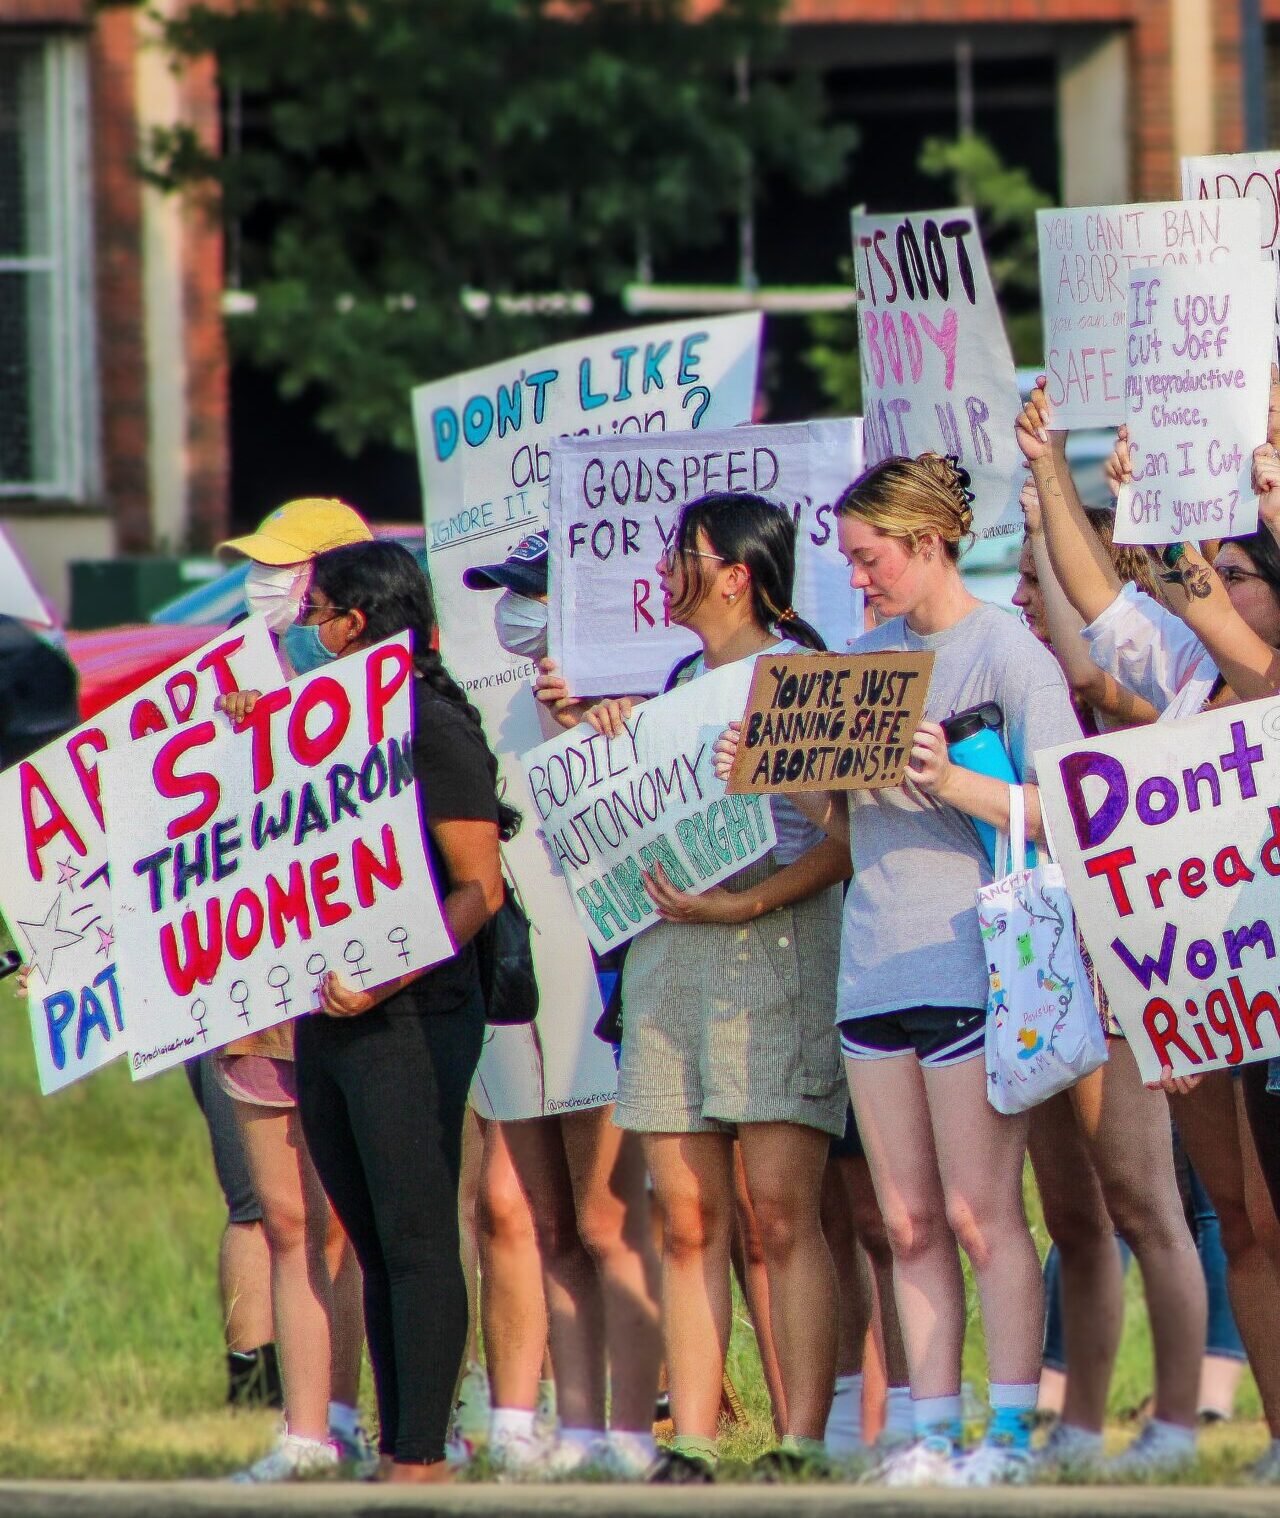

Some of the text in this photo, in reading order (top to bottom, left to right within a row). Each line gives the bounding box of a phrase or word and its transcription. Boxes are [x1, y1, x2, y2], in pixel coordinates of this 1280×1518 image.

[1045, 206, 1221, 251] YOU CAN'T BAN
[896, 216, 976, 305] NOT
[1128, 326, 1229, 367] cut off
[1130, 278, 1230, 357] If you
[863, 307, 959, 391] BODY
[1049, 348, 1120, 407] SAFE
[432, 332, 710, 461] DON'T LIKE
[1125, 374, 1143, 413] my
[1145, 368, 1246, 403] reproductive
[583, 447, 779, 509] GODSPEED
[1129, 439, 1242, 482] Can I Cut
[430, 502, 494, 547] IGNORE
[504, 491, 532, 521] IT.
[1130, 489, 1162, 525] Off
[568, 516, 641, 561] FOR
[770, 665, 919, 710] YOU'RE JUST
[152, 644, 411, 839] STOP
[744, 708, 910, 749] BANNING SAFE
[528, 711, 645, 821] BODILY
[751, 745, 904, 786] ABORTIONS!!
[1059, 720, 1264, 851] Dont
[553, 743, 706, 870] AUTONOMY
[132, 815, 241, 913] THE
[160, 823, 404, 997] WOMEN
